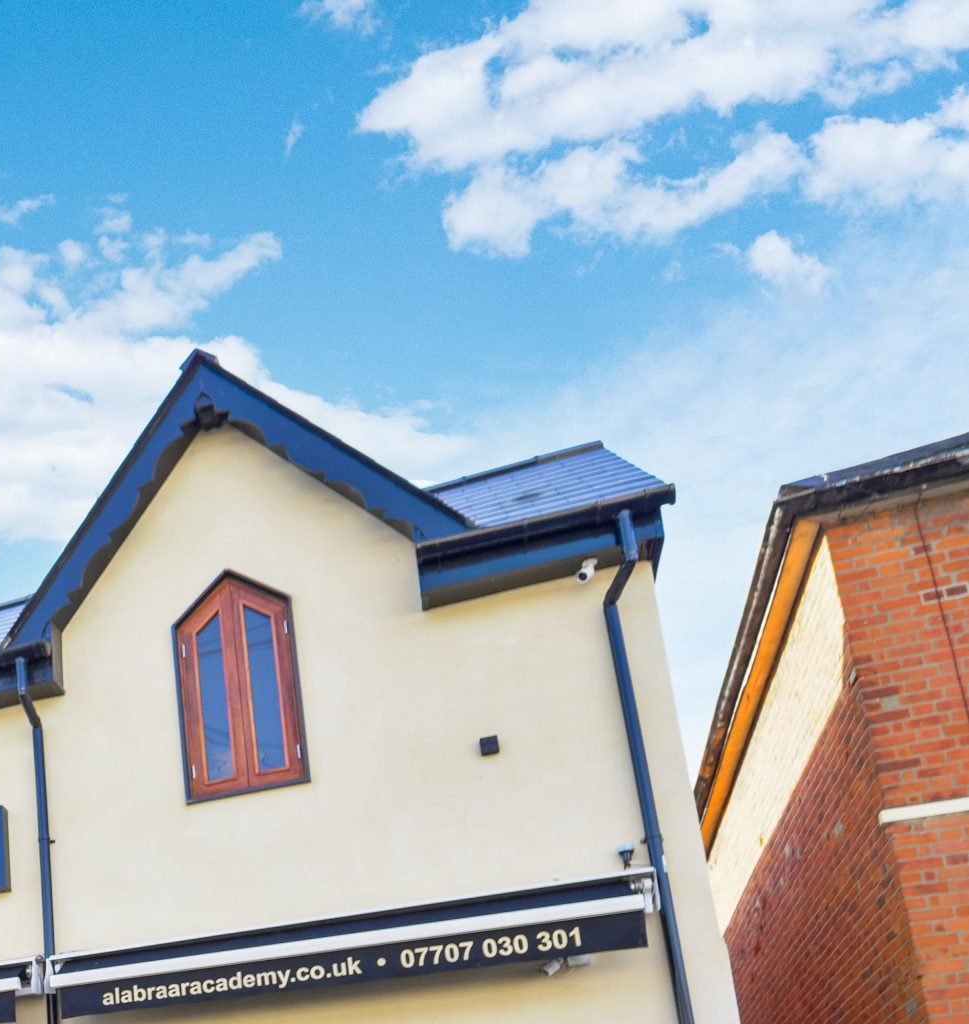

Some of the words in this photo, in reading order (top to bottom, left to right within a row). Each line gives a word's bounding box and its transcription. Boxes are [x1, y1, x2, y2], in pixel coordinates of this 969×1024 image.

[102, 957, 362, 1006] alabraaracademy.co.uk
[400, 941, 474, 968] 07707
[482, 934, 529, 958] 030
[536, 926, 582, 952] 301
